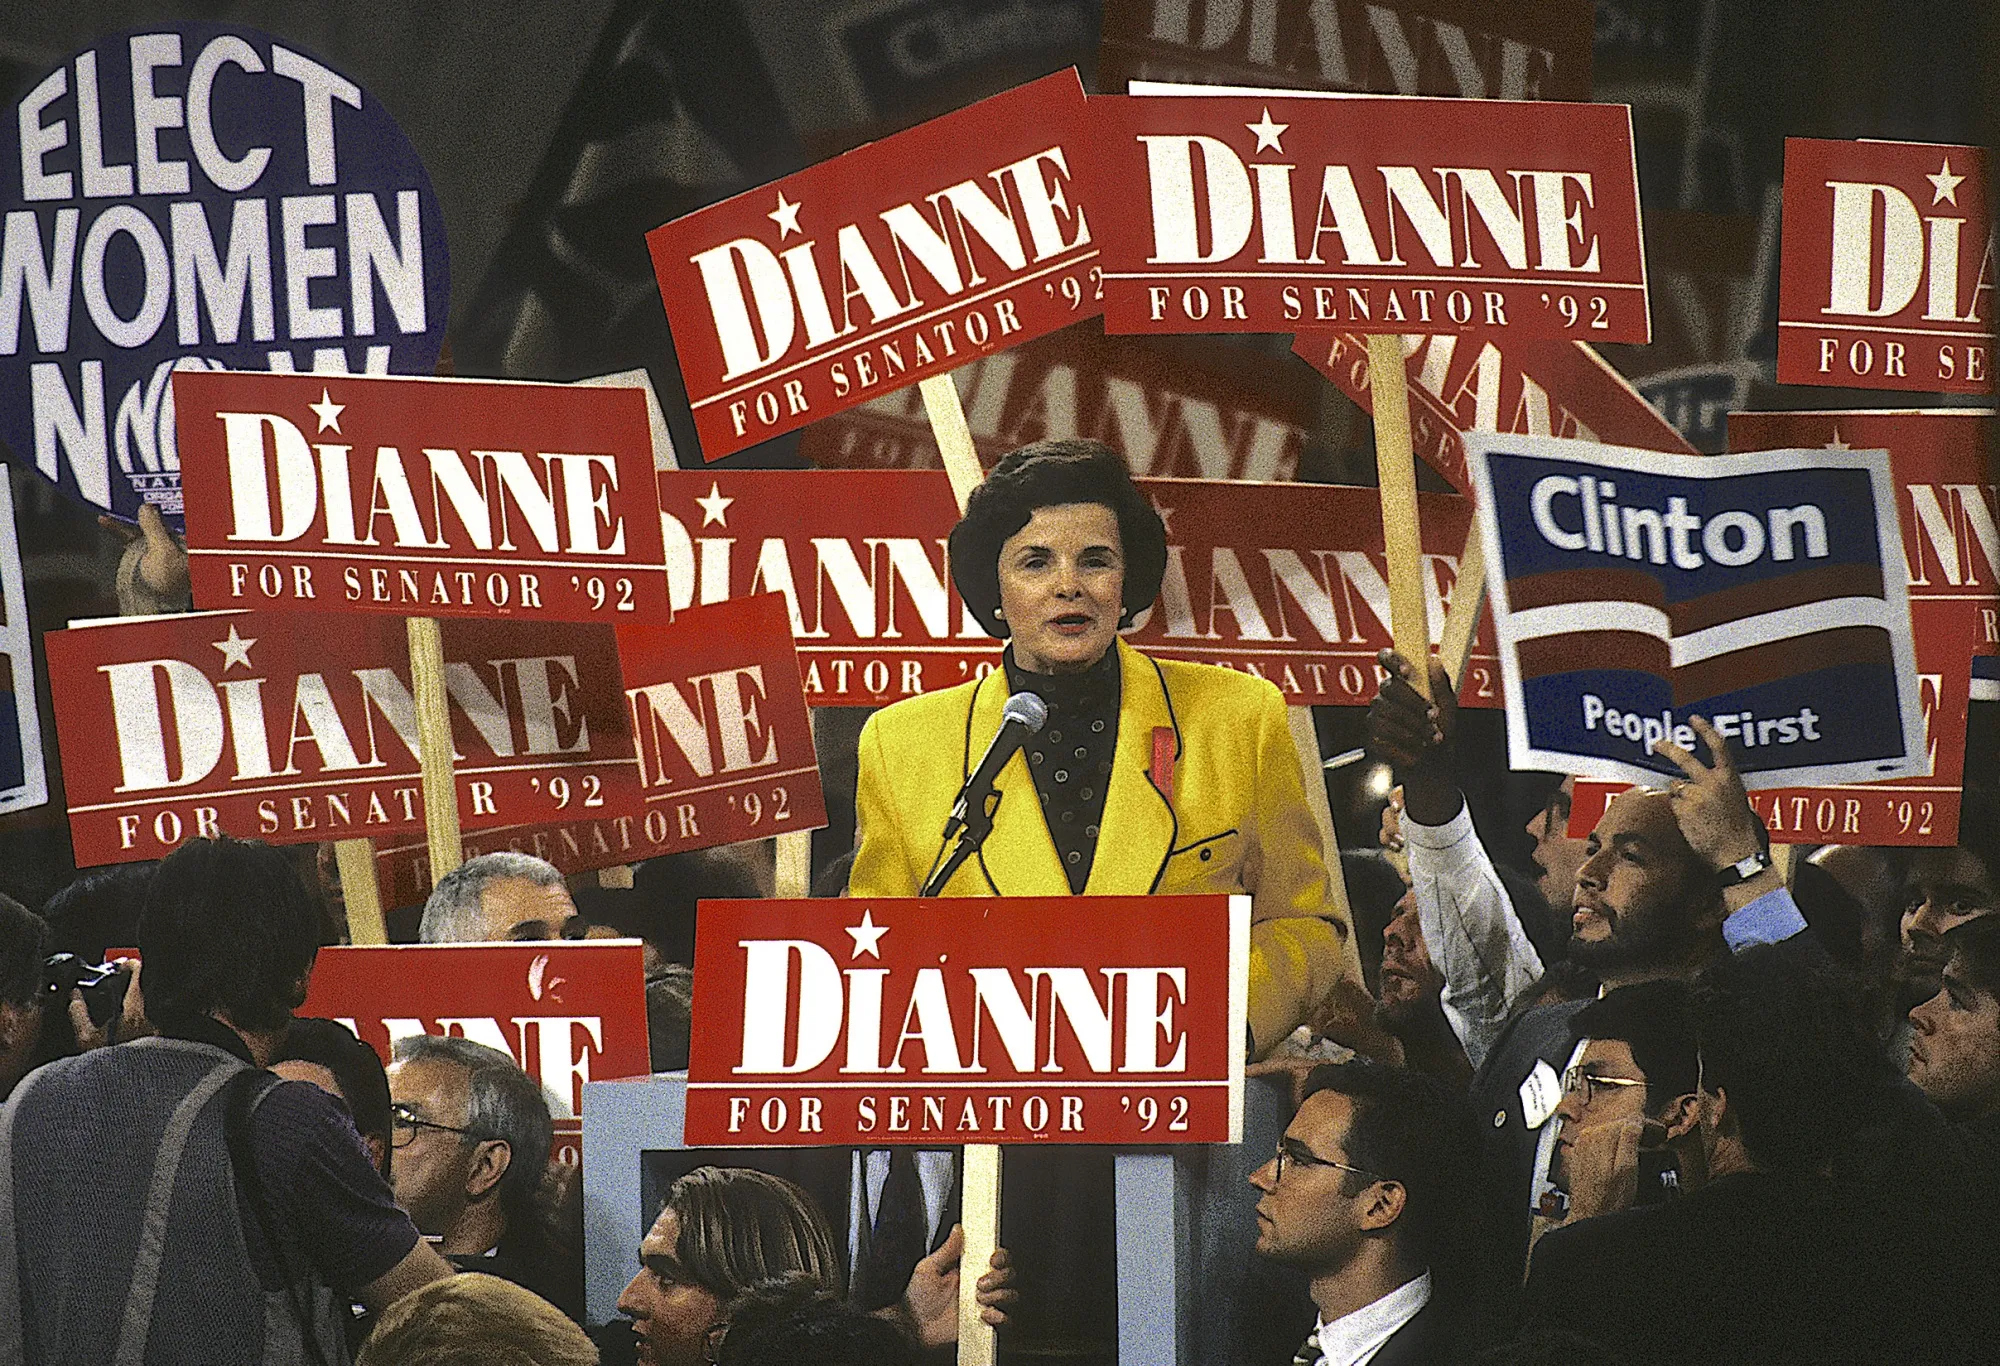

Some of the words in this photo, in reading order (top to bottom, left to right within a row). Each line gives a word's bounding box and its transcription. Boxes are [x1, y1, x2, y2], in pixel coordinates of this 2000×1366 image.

[18, 33, 362, 201] ELECT
[1137, 134, 1601, 273] DIANNE
[0, 190, 427, 356] WOMEN
[690, 146, 1092, 384] DIANNE
[1148, 287, 1249, 322] FOR
[1282, 285, 1508, 325] SENATOR
[1541, 293, 1609, 329] '92
[728, 379, 810, 437] FOR
[834, 301, 1023, 399] SENATOR
[1818, 338, 1907, 377] FOR
[216, 411, 627, 556] DIANNE
[1529, 475, 1830, 570] Clinton
[229, 564, 318, 600] FOR
[344, 567, 542, 609] SENATOR
[570, 576, 636, 612] '92
[1582, 693, 1697, 756] People
[1711, 707, 1822, 749] First
[117, 801, 220, 850] FOR
[258, 780, 499, 836] SENATR
[530, 775, 605, 810] '92
[728, 786, 792, 827] '92
[1887, 801, 1934, 836] '92
[733, 940, 1187, 1075] DIANNE
[728, 1096, 824, 1134] FOR
[857, 1095, 1086, 1134] SENATOR
[1121, 1095, 1191, 1132] '92
